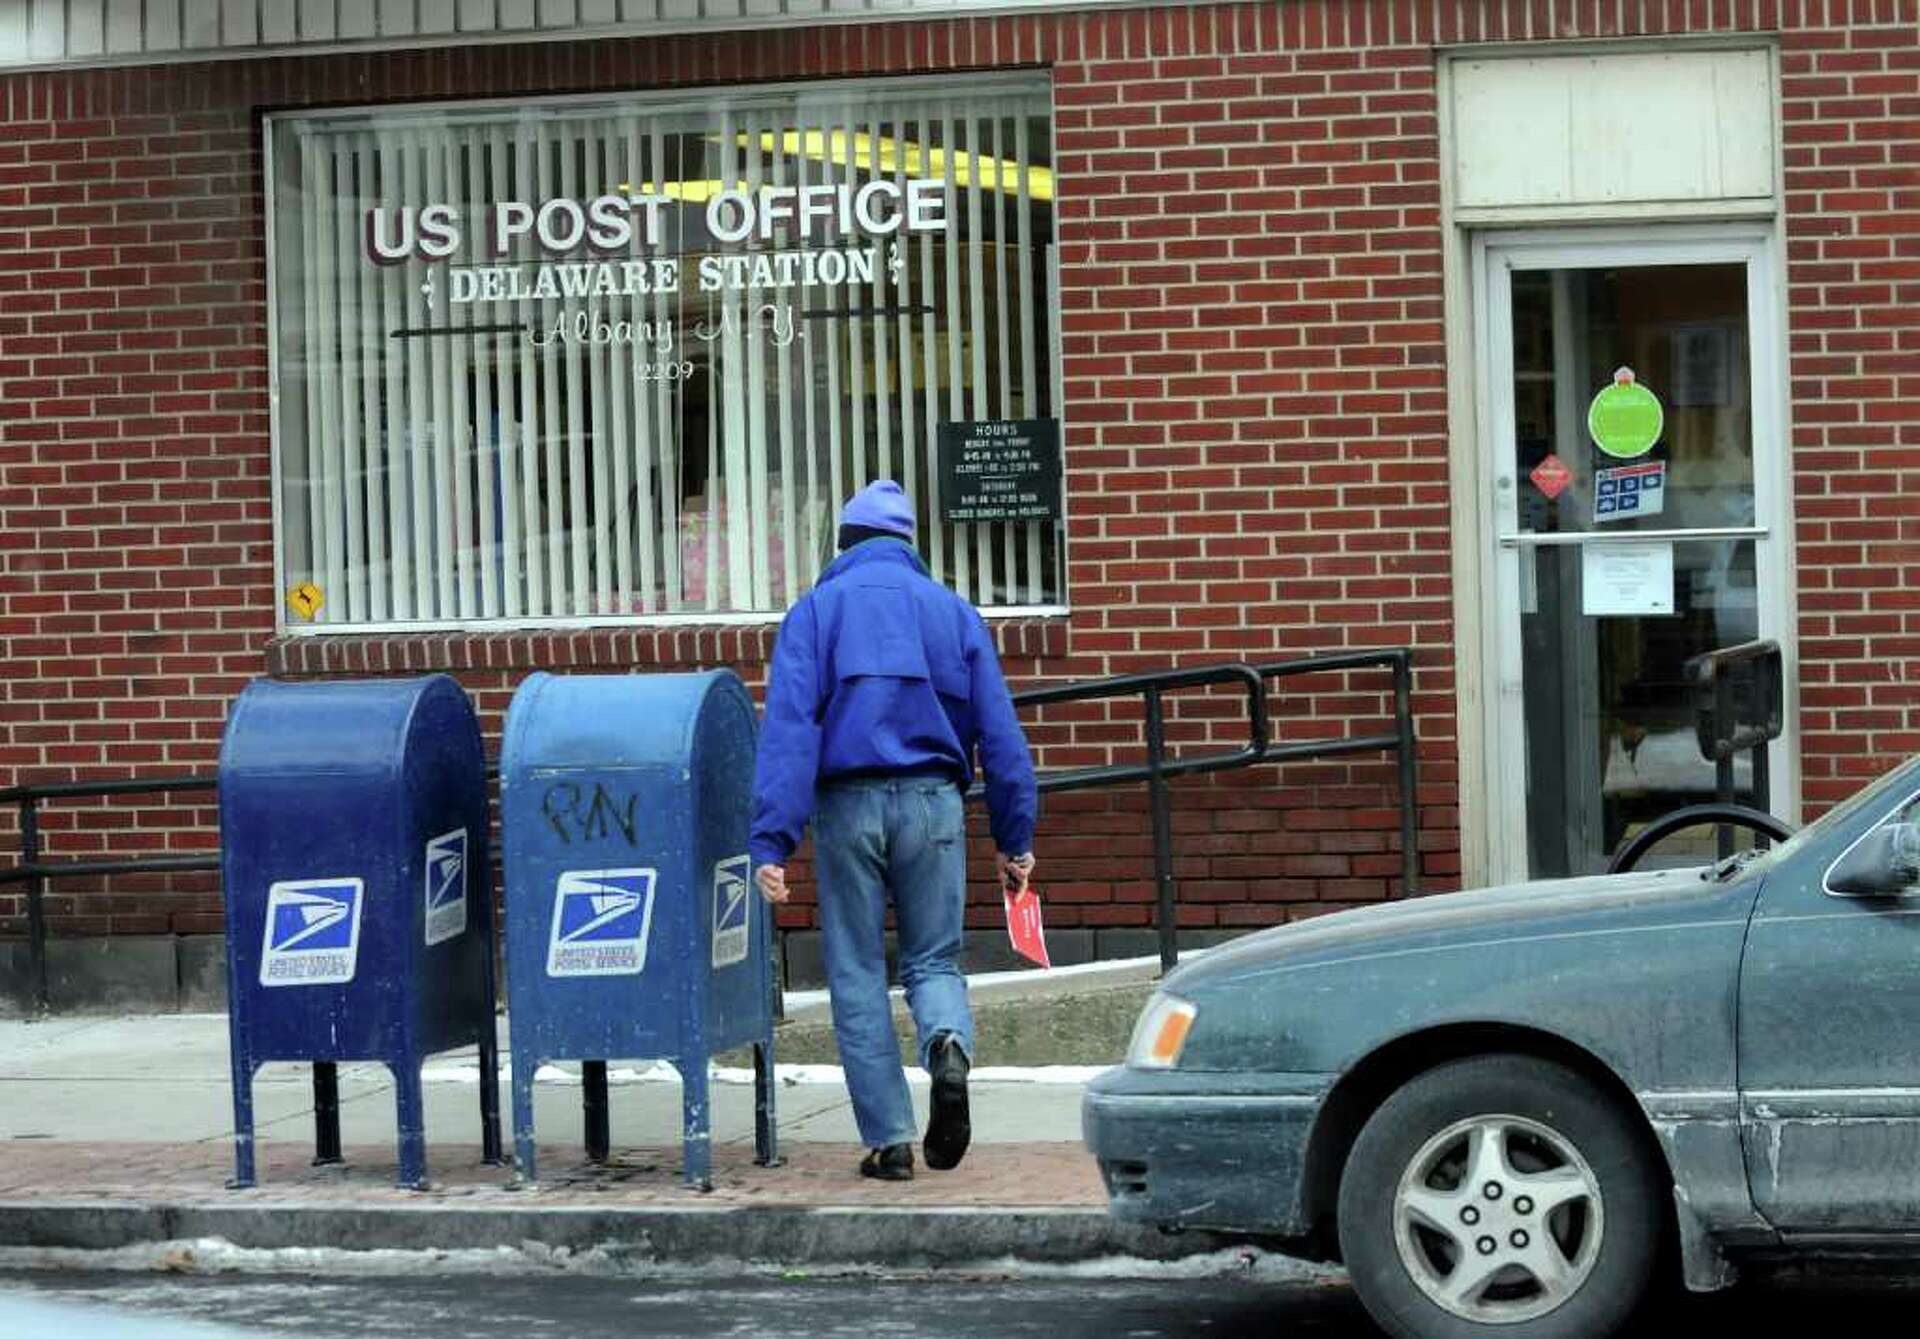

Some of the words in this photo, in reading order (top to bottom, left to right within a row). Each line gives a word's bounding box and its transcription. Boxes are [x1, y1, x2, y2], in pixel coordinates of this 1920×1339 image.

[367, 203, 460, 265] US
[488, 194, 672, 259] POST
[703, 179, 947, 244] OFFICE
[449, 259, 679, 303] DELAWARE
[699, 248, 877, 292] STATION
[527, 310, 673, 352] Albany
[975, 424, 1018, 436] HOURS
